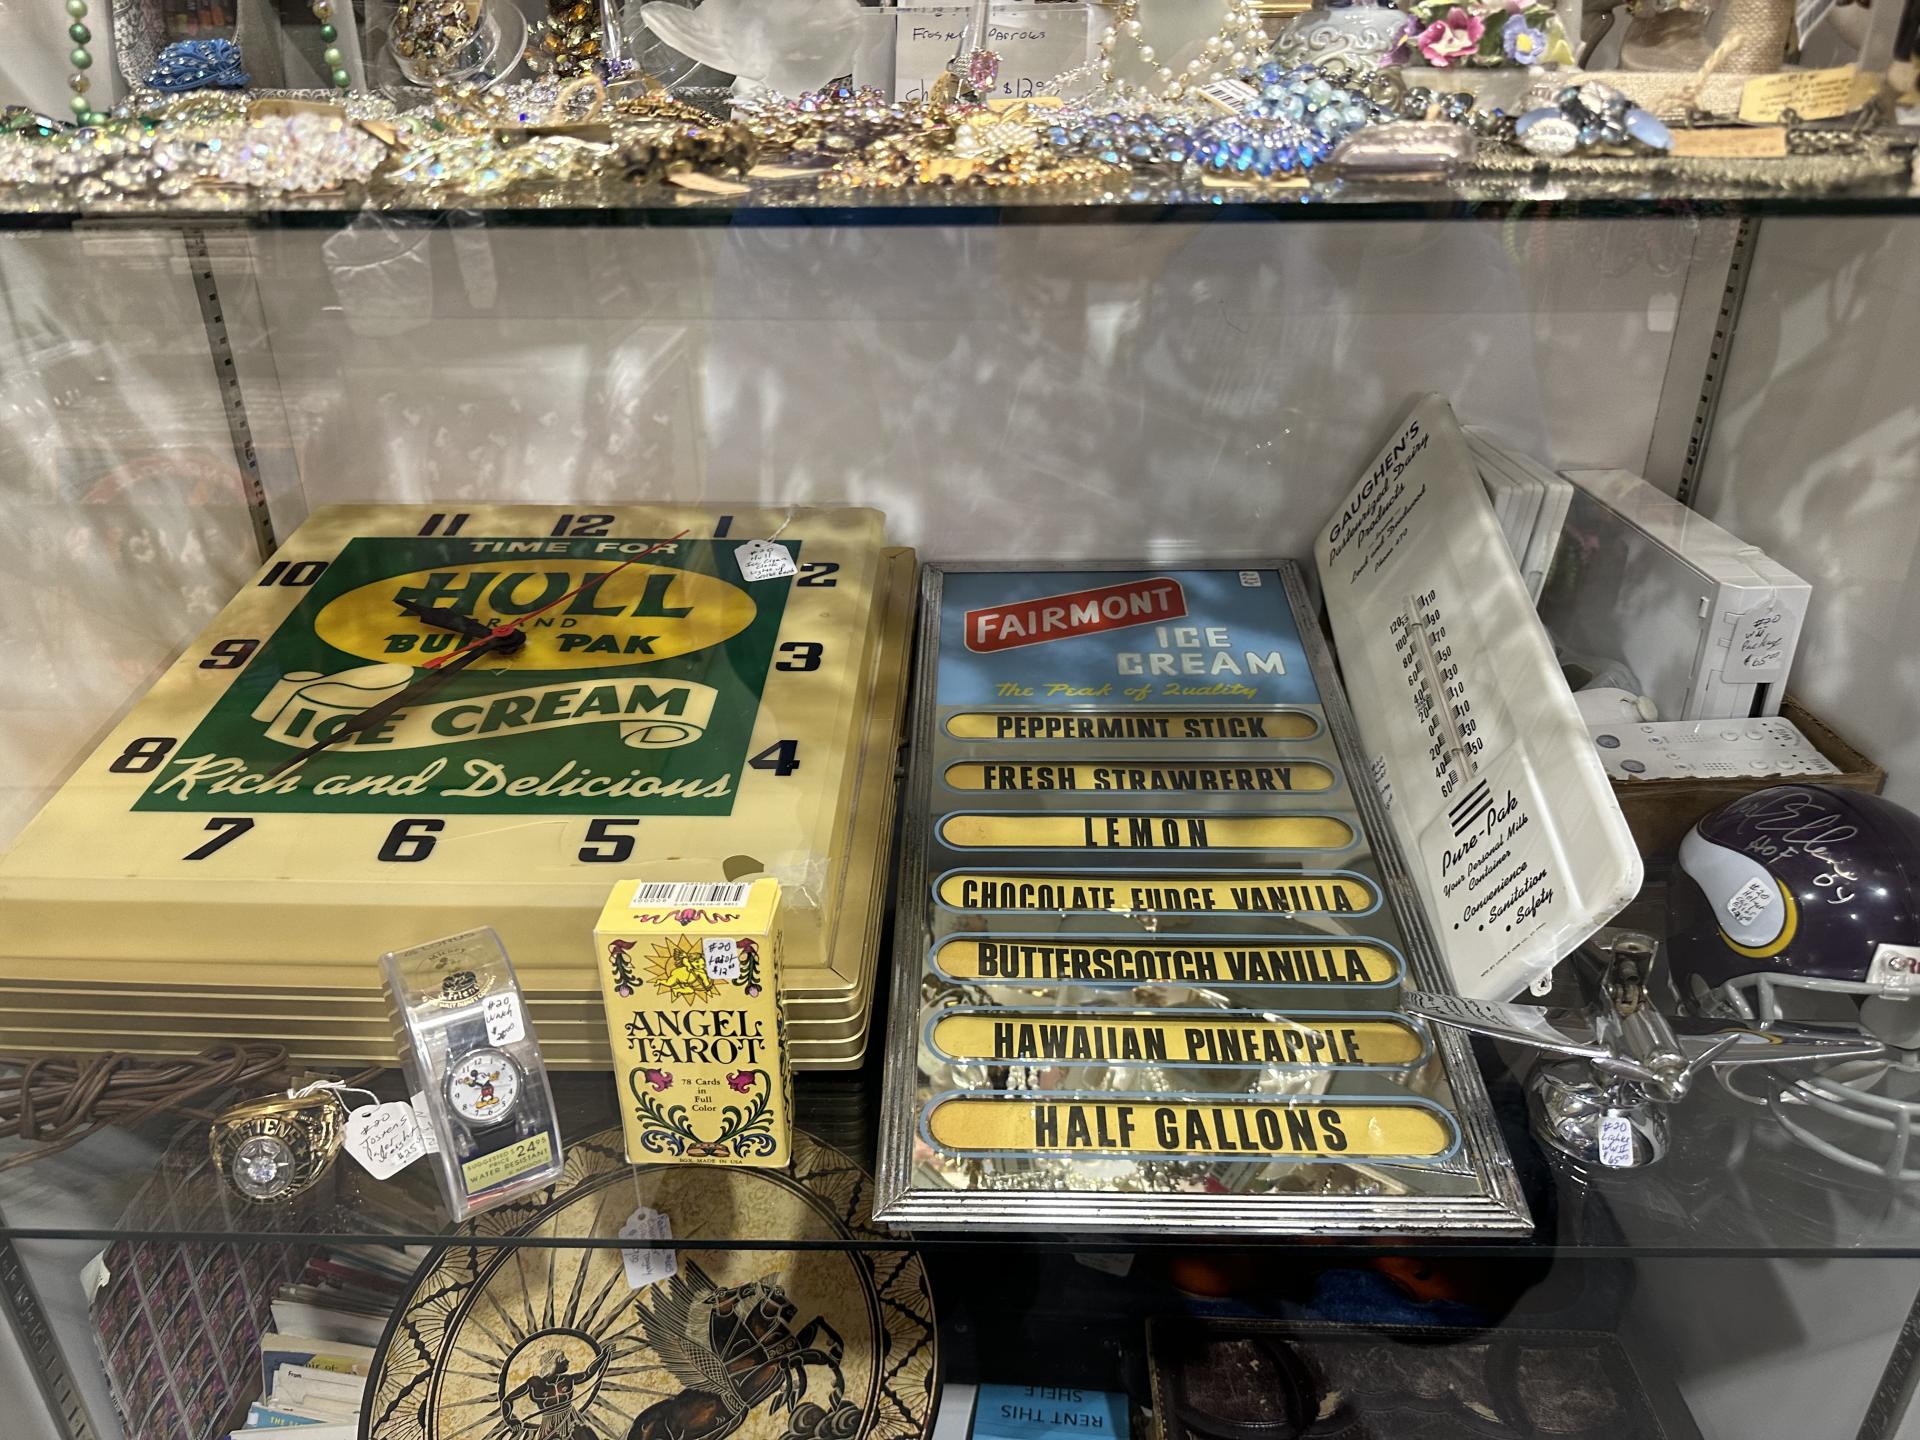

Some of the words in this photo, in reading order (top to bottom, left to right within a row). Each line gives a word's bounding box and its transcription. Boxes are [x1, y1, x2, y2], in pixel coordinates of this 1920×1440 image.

[1329, 420, 1420, 544] GAUGHEN'S
[1329, 478, 1390, 567] Pasteurized
[1393, 432, 1430, 481] Dairy
[417, 513, 471, 537] 11
[550, 514, 615, 537] 12
[713, 515, 734, 538] 1
[1357, 482, 1405, 549] Products
[469, 541, 572, 553] TIME
[595, 541, 680, 555] FOR
[257, 560, 330, 586] 10
[796, 562, 840, 587] 2
[393, 572, 695, 618] HOLL
[471, 616, 578, 629] RAND
[976, 586, 1173, 644] FAIRMONT
[1431, 609, 1441, 626] 90
[556, 633, 661, 655] PAK
[1155, 626, 1232, 648] ICE
[1436, 626, 1447, 644] 70
[199, 639, 261, 669] 9
[775, 642, 824, 672] 3
[1116, 651, 1286, 676] CREAM
[1402, 654, 1413, 669] 80
[1442, 645, 1453, 663] 50
[1407, 671, 1418, 687] 60
[1447, 663, 1459, 681] 30
[996, 683, 1034, 698] The
[1041, 683, 1111, 698] Peak
[1123, 683, 1152, 702] of
[1162, 683, 1259, 700] Quality
[1413, 688, 1424, 704] 40
[1454, 681, 1465, 698] 10
[284, 708, 408, 746] ICE
[430, 684, 692, 738] CREAM
[1459, 699, 1470, 718] 10
[996, 716, 1170, 739] PEPPERMINT
[1183, 717, 1269, 738] STICK
[1466, 718, 1477, 737] 30
[109, 737, 177, 773] 8
[747, 740, 800, 777] 4
[1429, 745, 1442, 762] 20
[1470, 737, 1484, 755] 50
[154, 753, 304, 801] Rich
[313, 757, 448, 797] and
[439, 759, 732, 799] Delicious
[983, 765, 1076, 790] FRESH
[1093, 767, 1293, 791] STRAWBERRY
[1435, 761, 1447, 779] 40
[1441, 780, 1453, 798] 60
[182, 817, 255, 861] 7
[377, 818, 446, 862] 6
[577, 818, 641, 863] 5
[1084, 816, 1208, 848] LEMON
[1442, 789, 1518, 878] Pure-Pak
[1443, 874, 1465, 898] Your
[1467, 834, 1504, 876] Personal
[1506, 812, 1529, 841] Milk
[1468, 849, 1512, 891] Container
[962, 879, 1115, 910] CHOCOLATE
[1131, 886, 1214, 911] FUDGE
[1229, 884, 1354, 912] VANILLA
[1463, 861, 1529, 922] Convenience
[1488, 868, 1548, 924] Sanitation
[1515, 887, 1555, 925] Safety
[977, 942, 1218, 982] BUTTERSCOTCH
[1222, 949, 1371, 983] VANILLA
[625, 1010, 762, 1037] ANGEL
[628, 1037, 766, 1064] TAROT
[994, 1021, 1167, 1062] HAWAIIAN
[1186, 1028, 1365, 1065] PINEAPPLE
[695, 1078, 721, 1086] Cards
[691, 1105, 717, 1113] Color
[1034, 1104, 1136, 1149] HALF
[1155, 1107, 1349, 1153] GALLONS
[470, 1167, 501, 1183] WATER
[504, 1147, 548, 1171] RESISTANT
[287, 1370, 303, 1379] From
[1001, 1404, 1045, 1423] THIS
[1050, 1411, 1103, 1428] RENT
